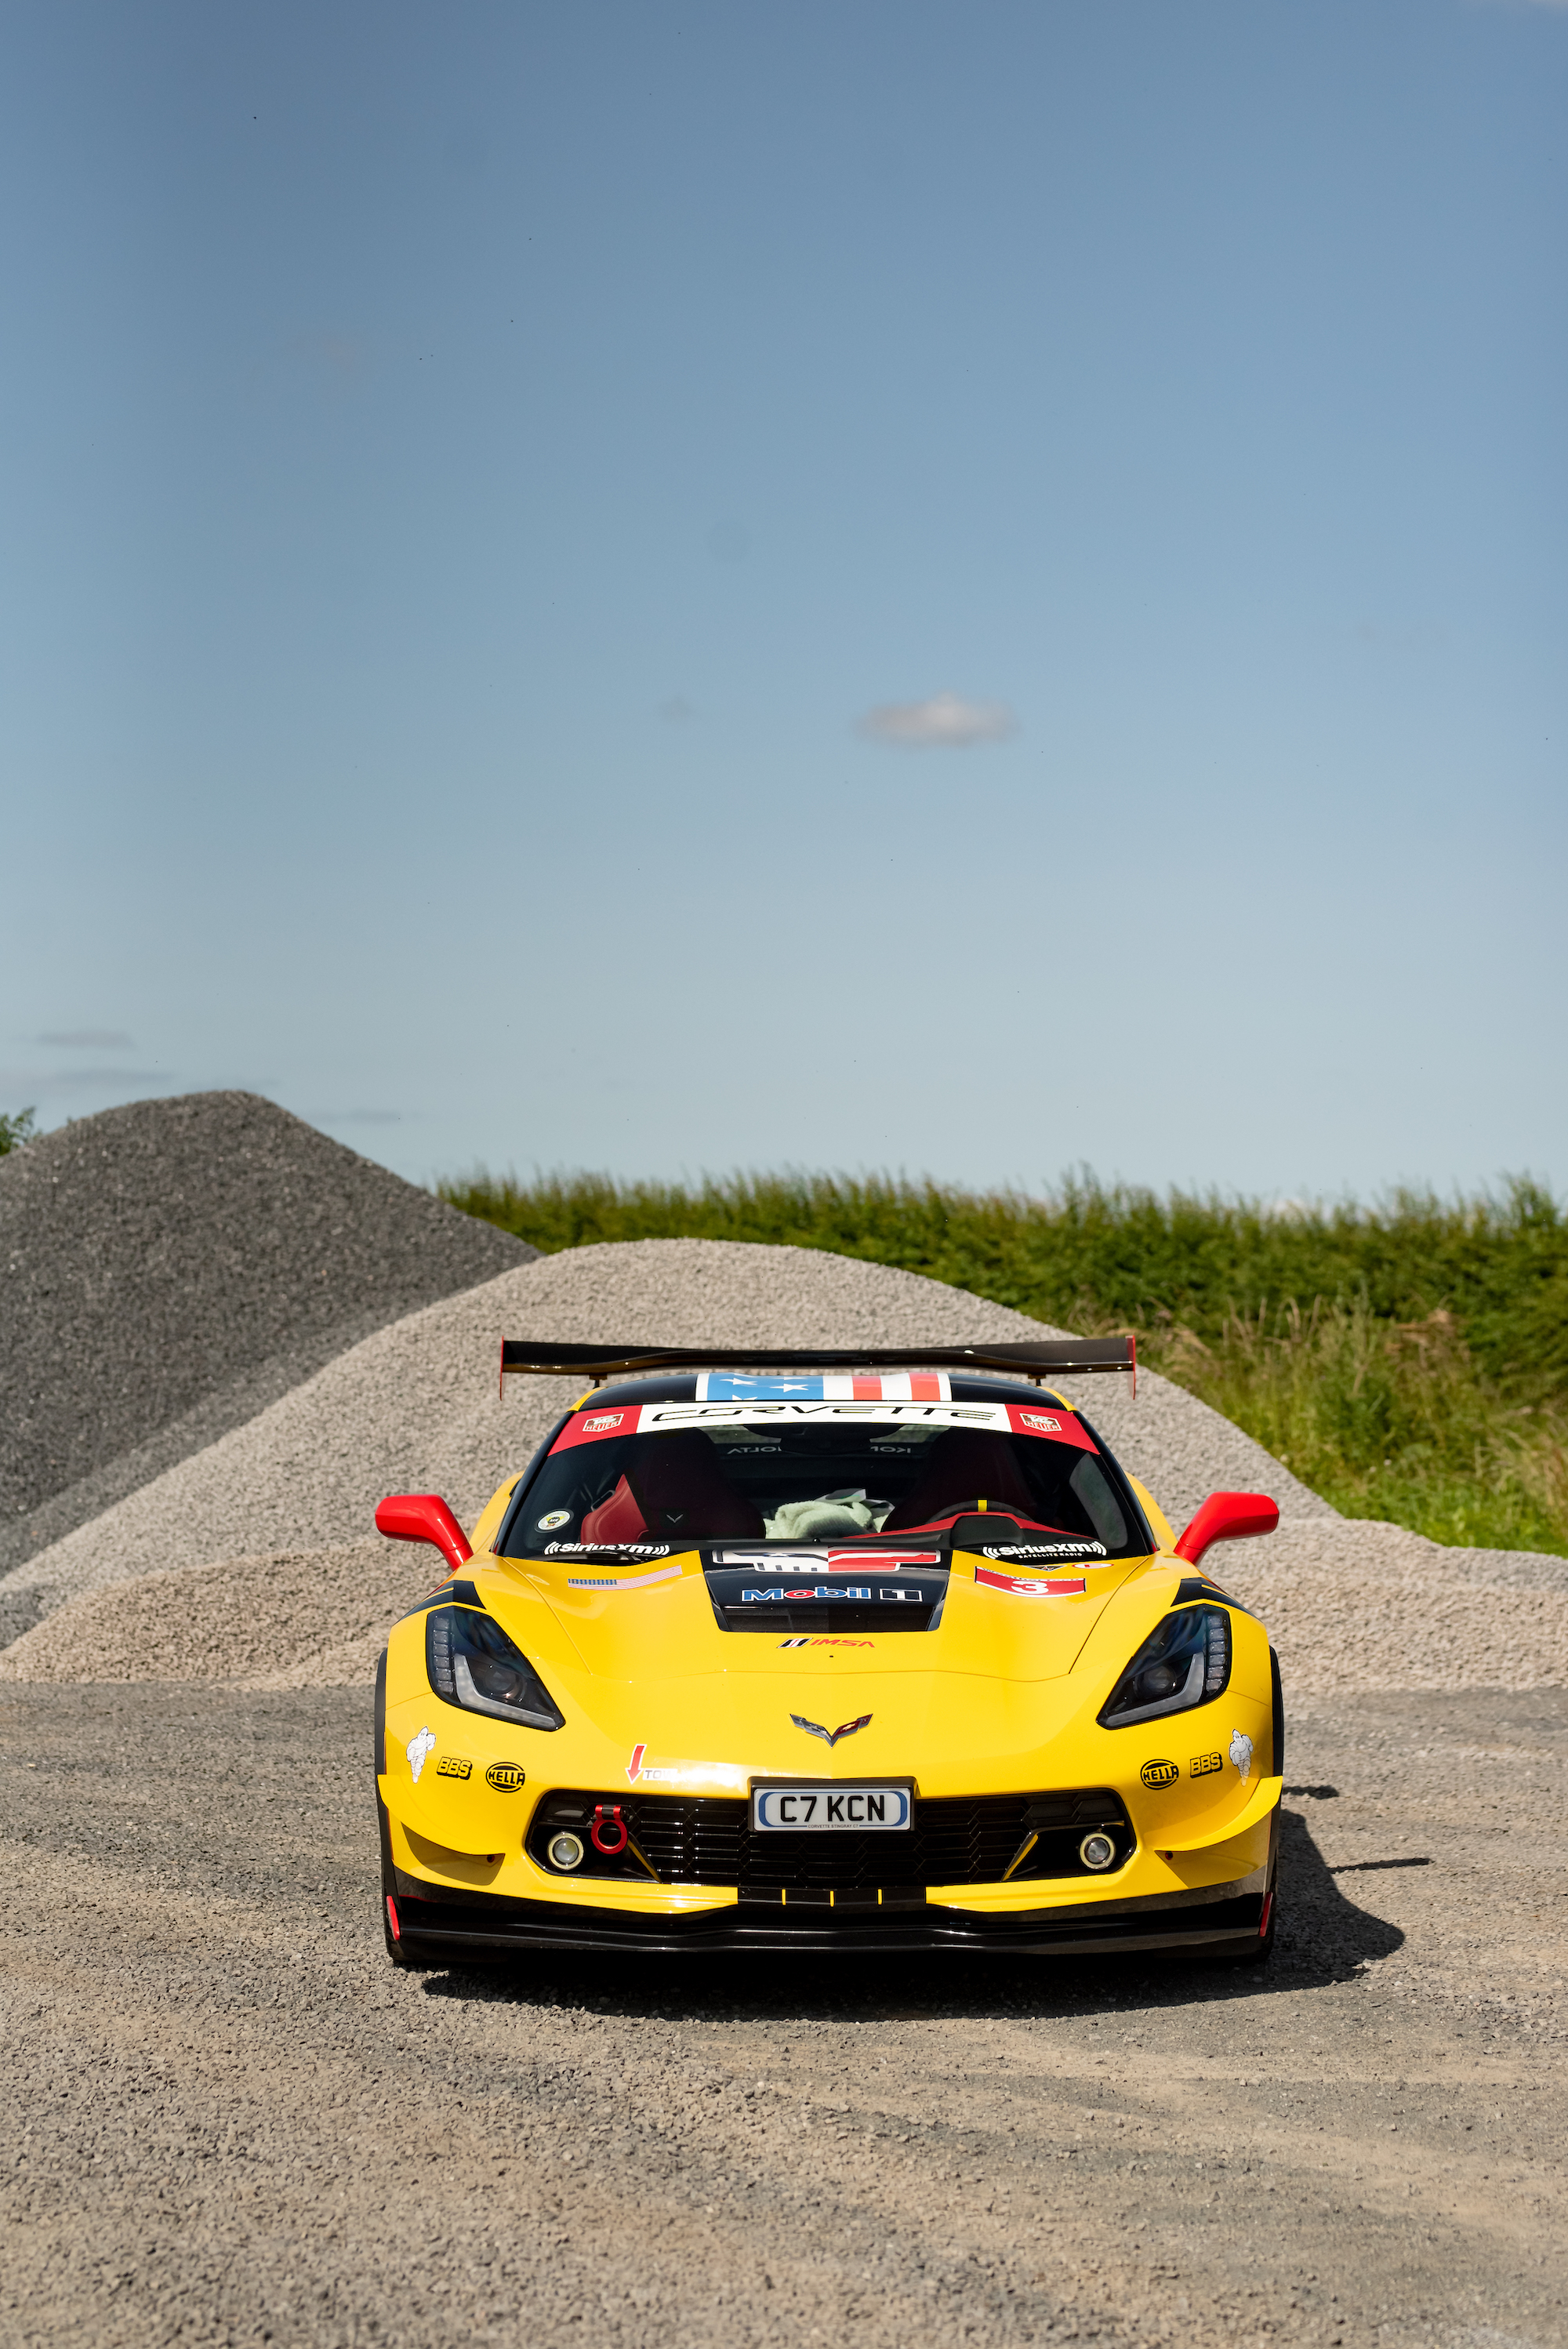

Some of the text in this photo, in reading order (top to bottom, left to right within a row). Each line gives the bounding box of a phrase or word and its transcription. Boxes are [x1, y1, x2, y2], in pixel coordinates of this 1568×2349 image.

[652, 1405, 996, 1421] CORVETTE
[742, 1586, 871, 1602] Mobil
[1011, 1580, 1049, 1595] 3
[810, 1639, 875, 1648] IMSA
[437, 1756, 473, 1781] BBS
[1142, 1765, 1179, 1781] HELLA
[1189, 1752, 1223, 1778] BBS
[488, 1770, 525, 1786] HELLA
[780, 1795, 884, 1822] C7 KCN
